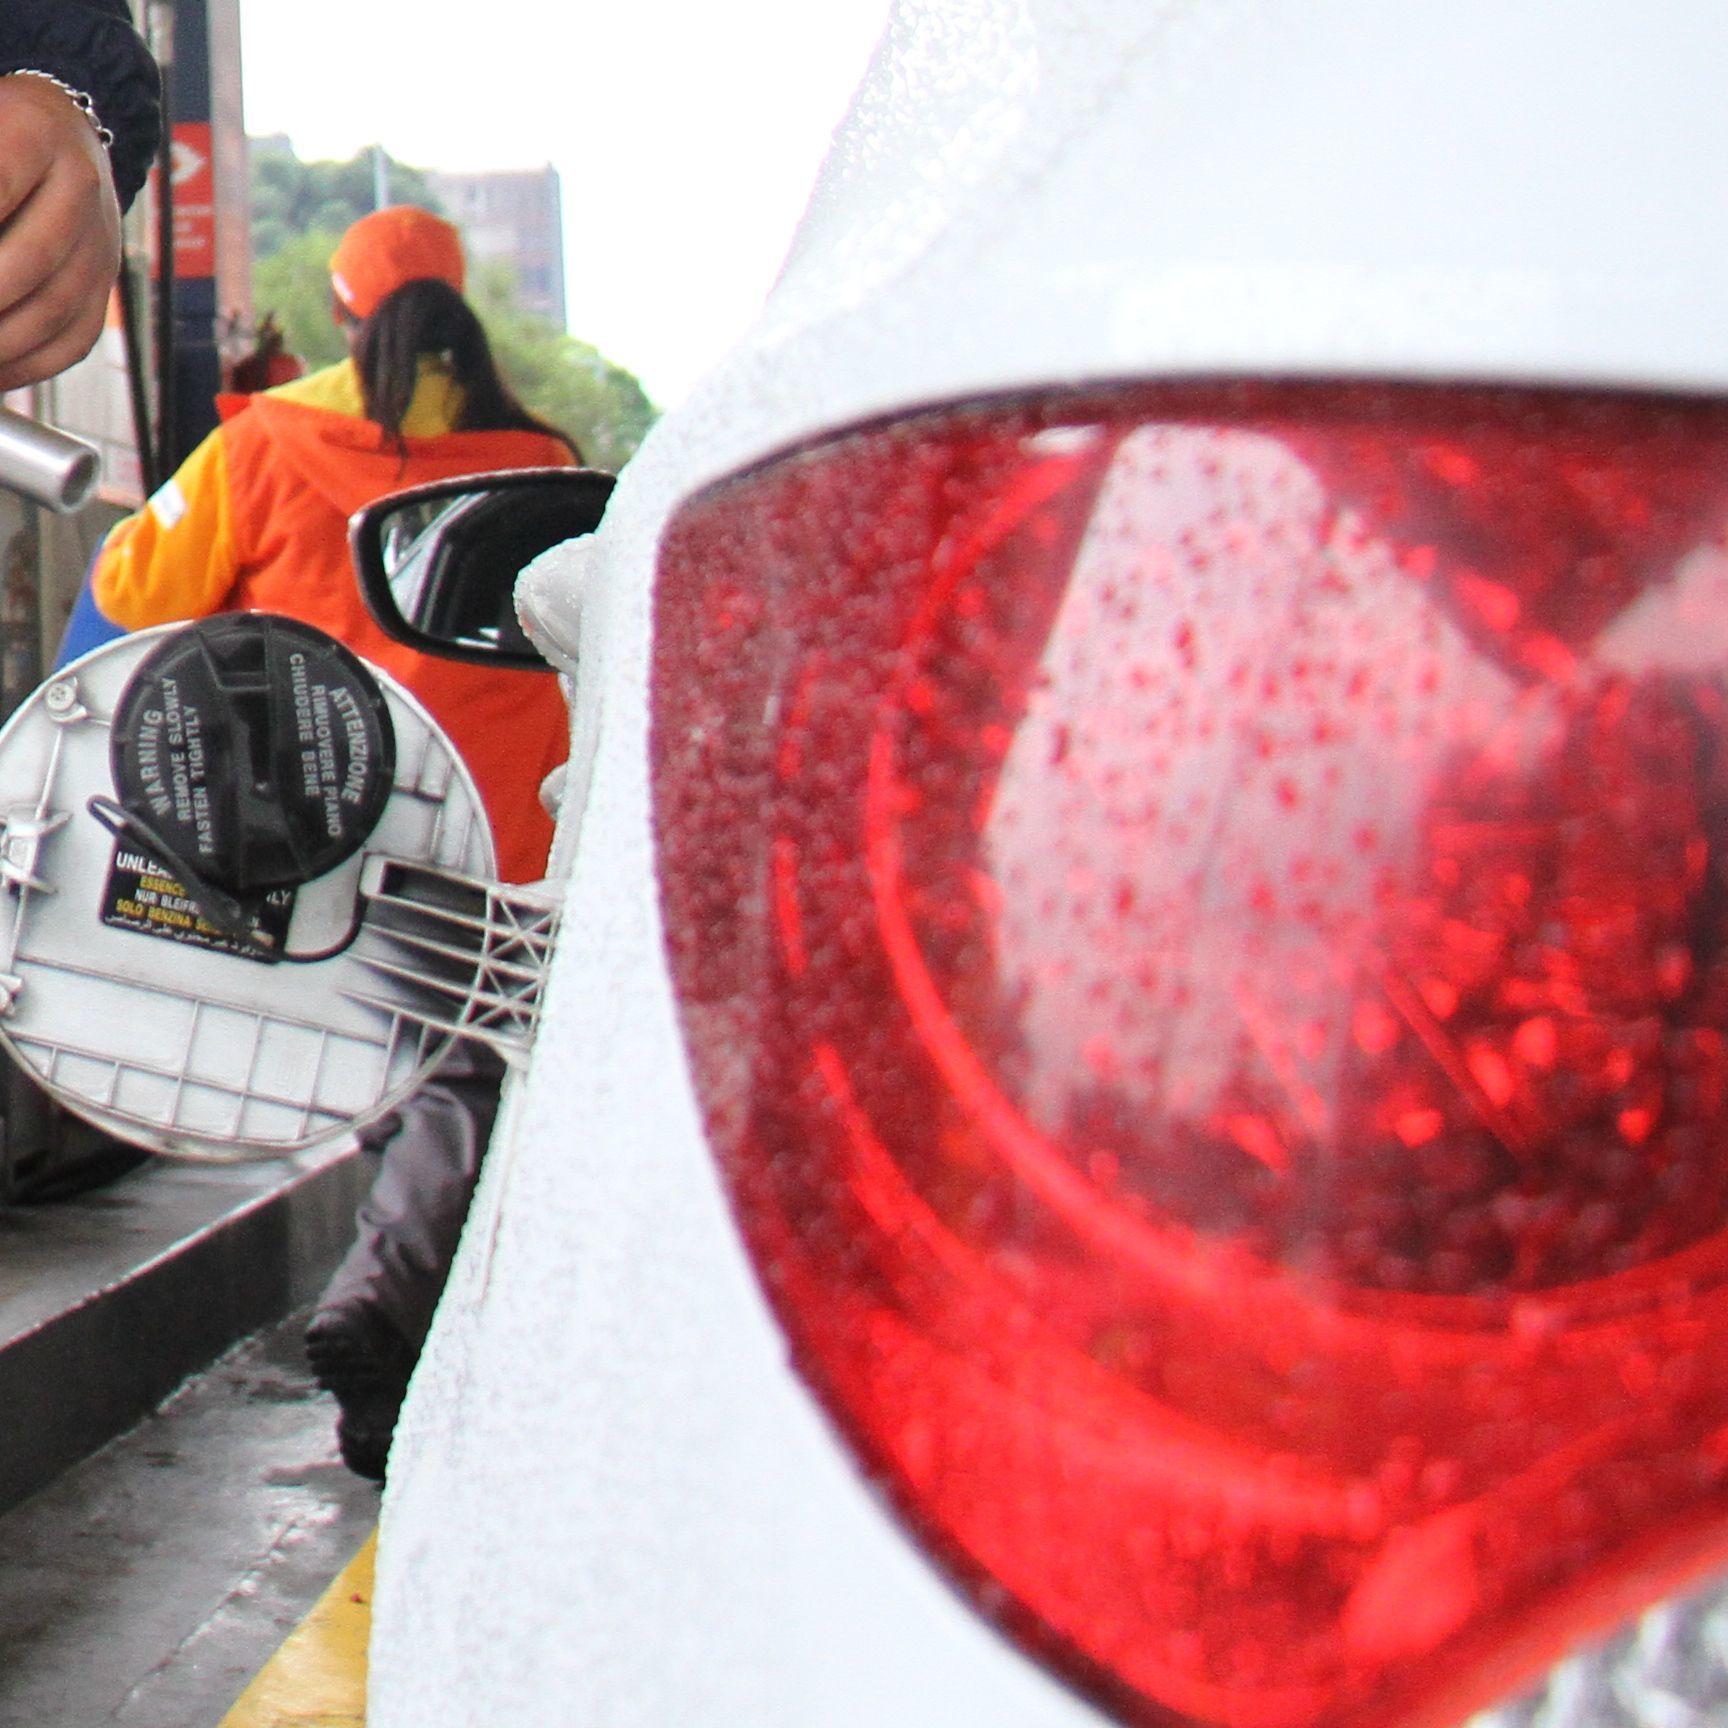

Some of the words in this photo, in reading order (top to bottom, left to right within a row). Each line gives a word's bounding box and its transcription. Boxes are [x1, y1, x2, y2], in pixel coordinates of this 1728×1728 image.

[161, 677, 184, 746] SLOWLY
[290, 653, 314, 742] CHIUDERE
[138, 709, 171, 816] WARNING
[183, 705, 205, 780] TIGHTLY
[311, 684, 336, 783] RIMUOVERE
[328, 686, 369, 805] ATTENZIONE
[170, 751, 192, 821] REMOVE
[301, 750, 321, 797] BENE
[193, 786, 215, 854] FASTEN
[322, 785, 343, 837] PIANO
[116, 898, 144, 915] SOLO
[134, 889, 157, 905] NUR
